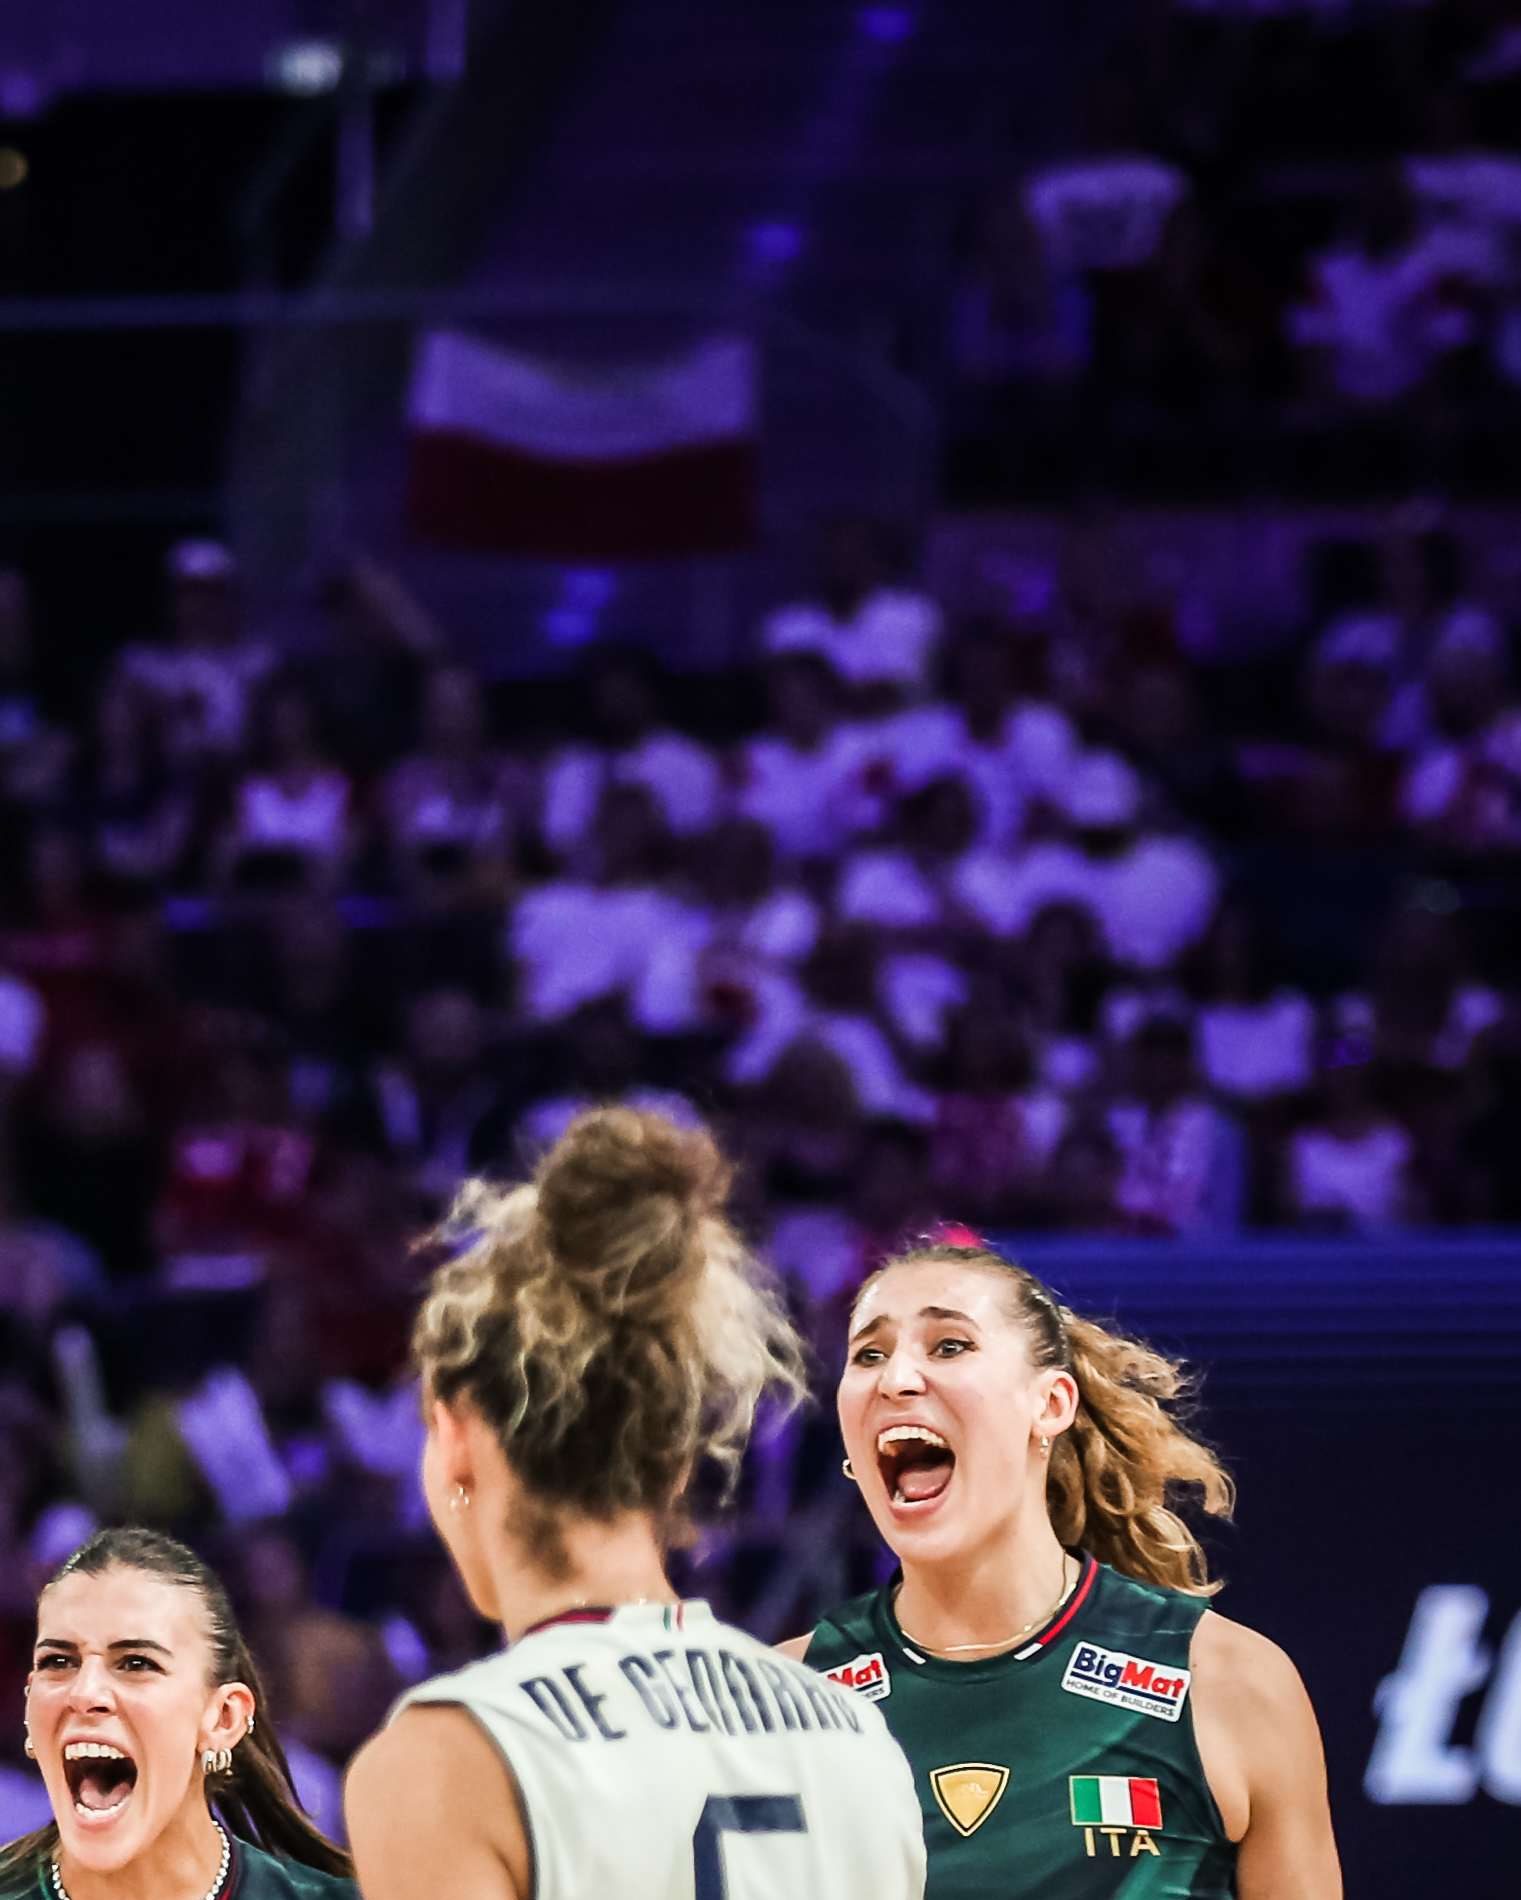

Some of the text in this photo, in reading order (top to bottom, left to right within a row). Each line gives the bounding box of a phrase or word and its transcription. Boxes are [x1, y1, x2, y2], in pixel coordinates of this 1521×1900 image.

[1074, 1646, 1184, 1698] BigMat
[1066, 1679, 1099, 1696] HOME
[1084, 1828, 1161, 1857] ITA
